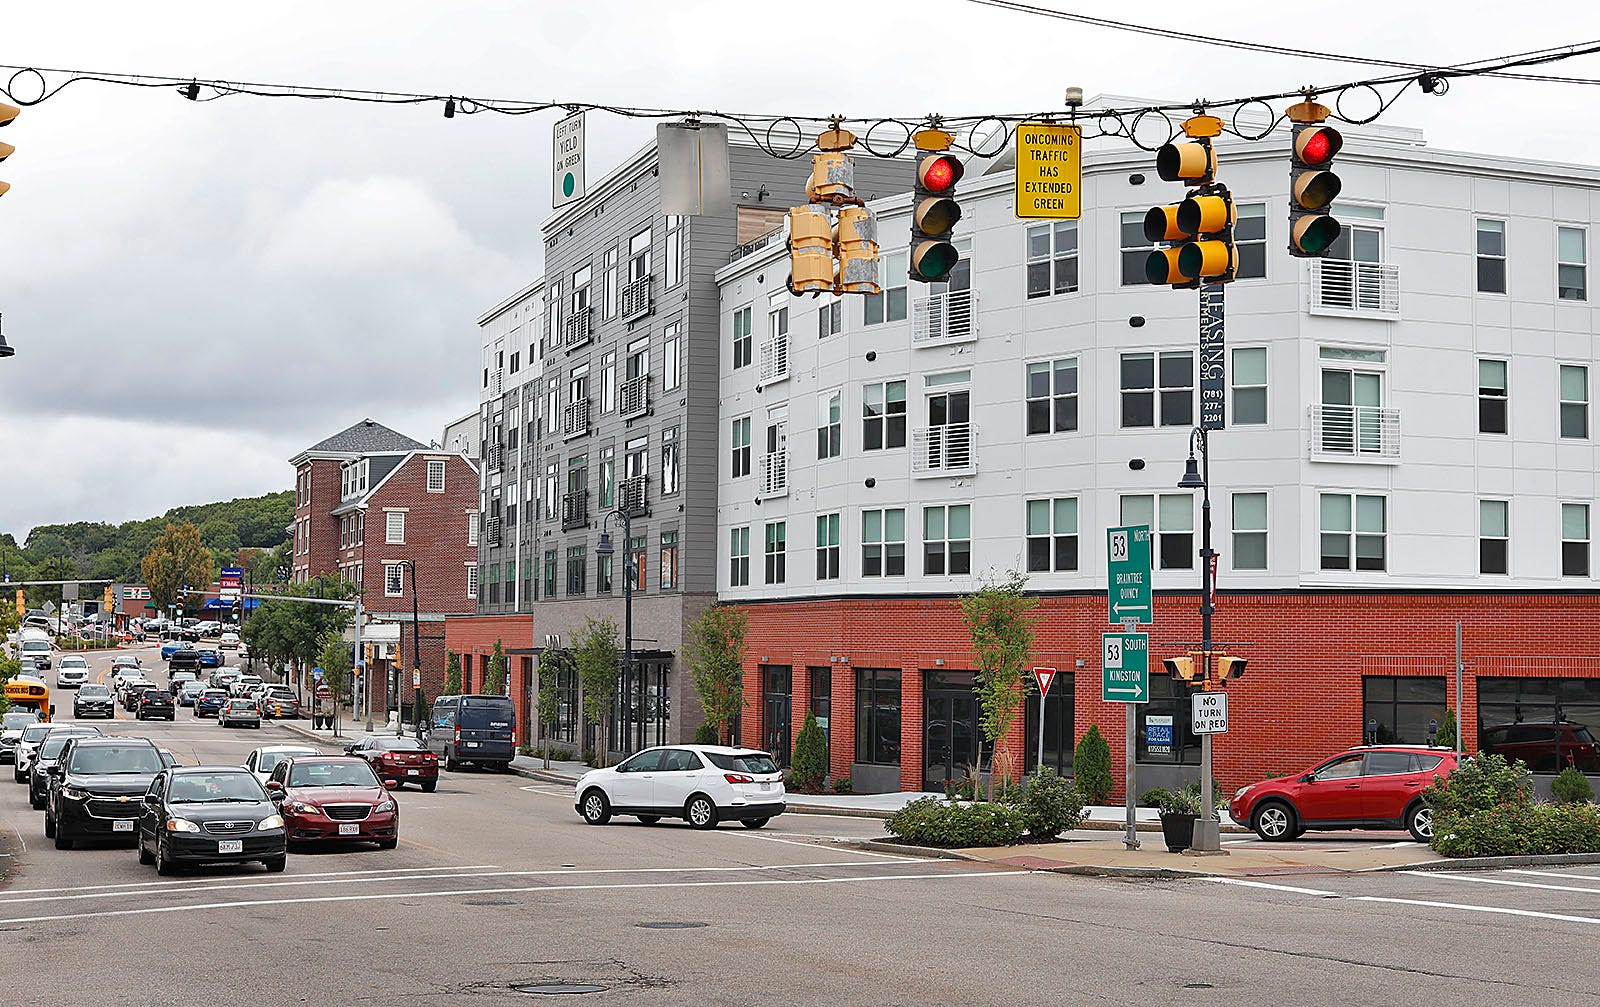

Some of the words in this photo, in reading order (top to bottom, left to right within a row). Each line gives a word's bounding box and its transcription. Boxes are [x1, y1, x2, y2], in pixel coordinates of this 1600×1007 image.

[557, 125, 567, 139] LEFT
[569, 119, 581, 132] TURN
[560, 135, 578, 154] YIELD
[1025, 133, 1073, 146] ONCOMING
[1030, 149, 1068, 161] TRAFFIC
[557, 160, 563, 171] ON
[565, 152, 580, 167] GREEN
[1039, 165, 1059, 177] HAS
[1025, 181, 1072, 194] EXTENDED
[1034, 198, 1064, 209] GREEN
[1208, 291, 1224, 380] LEASING
[1203, 390, 1223, 400] (781)
[1204, 402, 1222, 410] 277-
[1203, 414, 1222, 422] 2201
[1133, 529, 1150, 542] NORTH
[1113, 535, 1126, 557] 53
[1116, 572, 1143, 585] BRAINTREE
[1120, 588, 1139, 599] QUINCY
[1124, 638, 1147, 651] SOUTH
[1107, 644, 1120, 661] 53
[1109, 670, 1141, 682] KINGSTON
[1202, 697, 1217, 706] NO
[1198, 709, 1222, 718] TURN
[1195, 721, 1206, 729] ON
[1209, 719, 1226, 730] RED
